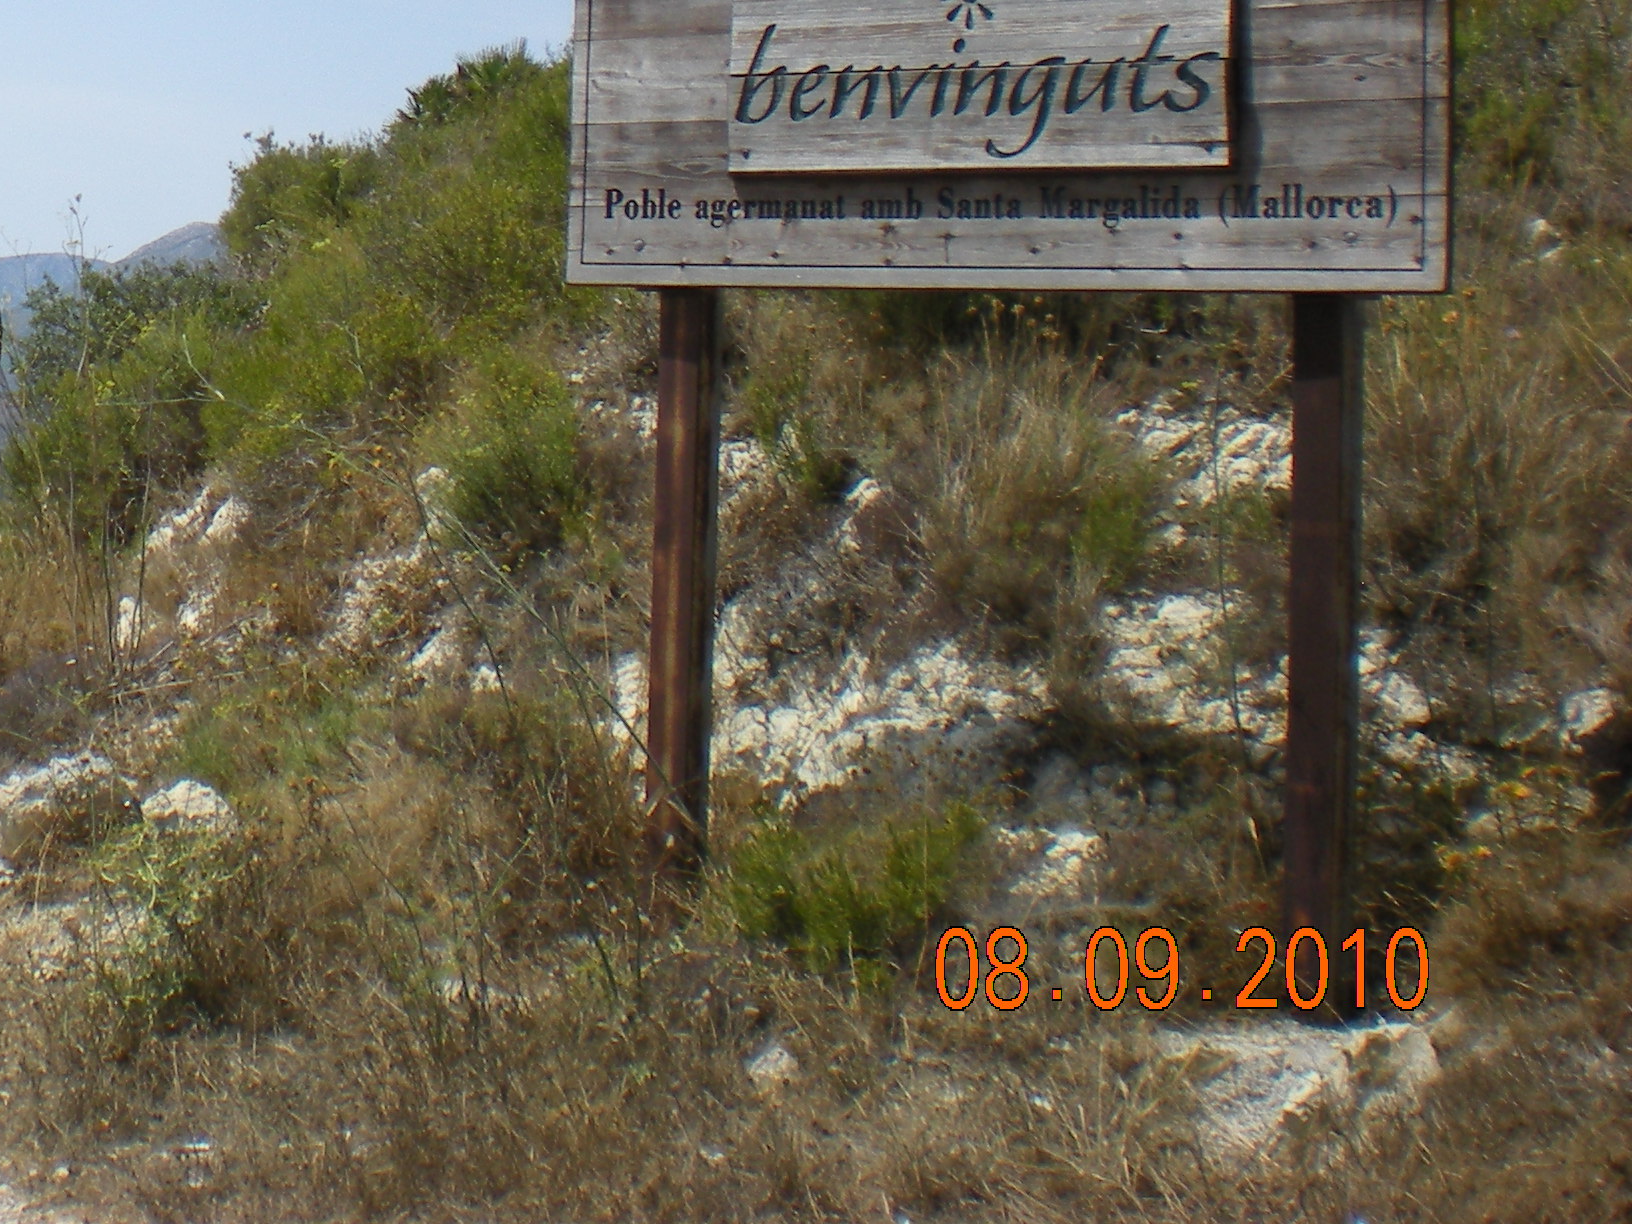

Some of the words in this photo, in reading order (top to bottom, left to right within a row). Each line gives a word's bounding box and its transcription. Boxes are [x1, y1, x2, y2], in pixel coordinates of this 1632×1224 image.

[733, 24, 1221, 160] benvinguts
[604, 188, 682, 219] Poble
[695, 194, 846, 228] agermanat
[861, 187, 922, 219] amb
[938, 186, 1023, 220] Santa
[1039, 185, 1200, 229] Margalida
[1218, 183, 1399, 228] (Mallorca)
